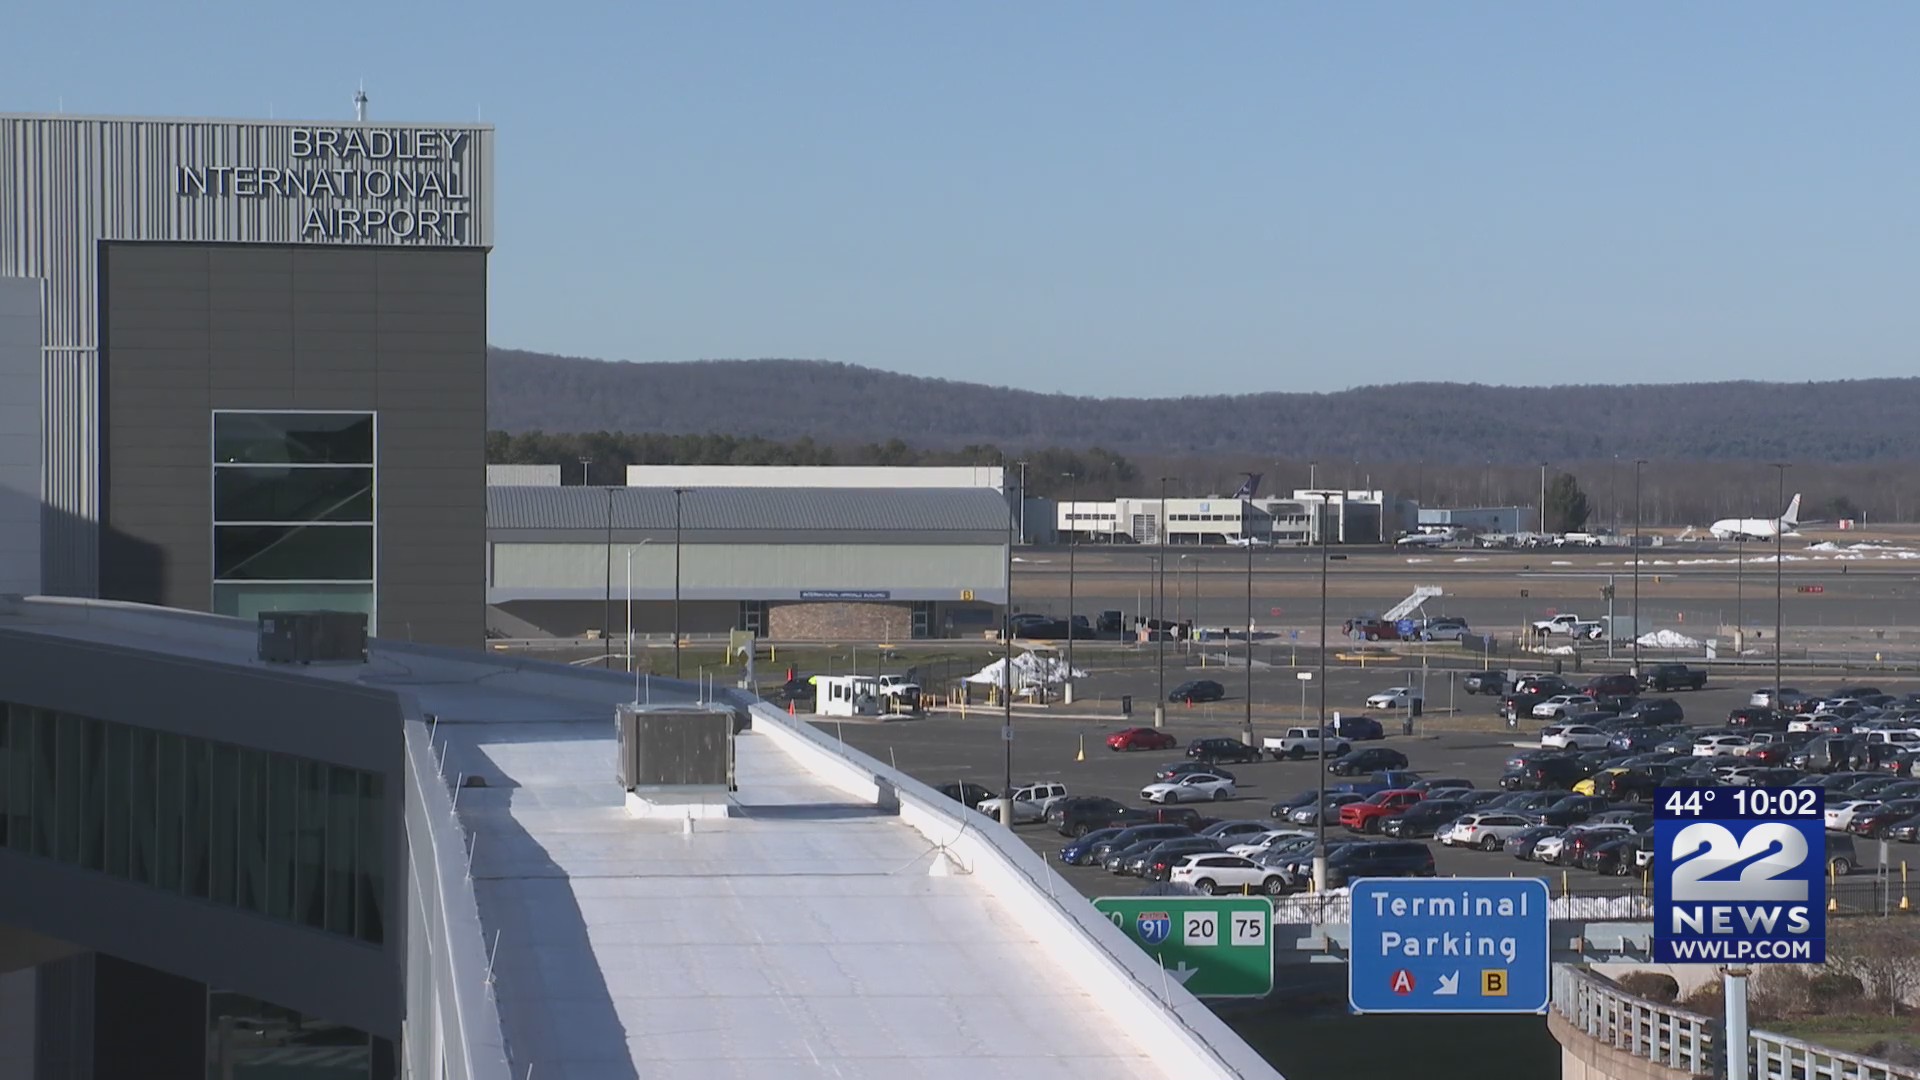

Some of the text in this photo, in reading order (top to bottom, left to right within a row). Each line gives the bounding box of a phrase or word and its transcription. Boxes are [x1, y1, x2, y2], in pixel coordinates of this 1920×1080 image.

[291, 128, 464, 160] BRADLEY
[175, 165, 464, 199] INTERNATIONAL
[302, 207, 464, 238] AIRPORT
[1371, 891, 1528, 917] Terminal
[1142, 920, 1162, 939] 91
[1188, 919, 1214, 938] 20
[1235, 919, 1261, 938] 75
[1381, 931, 1516, 964] Parking
[1393, 969, 1502, 992] A B
